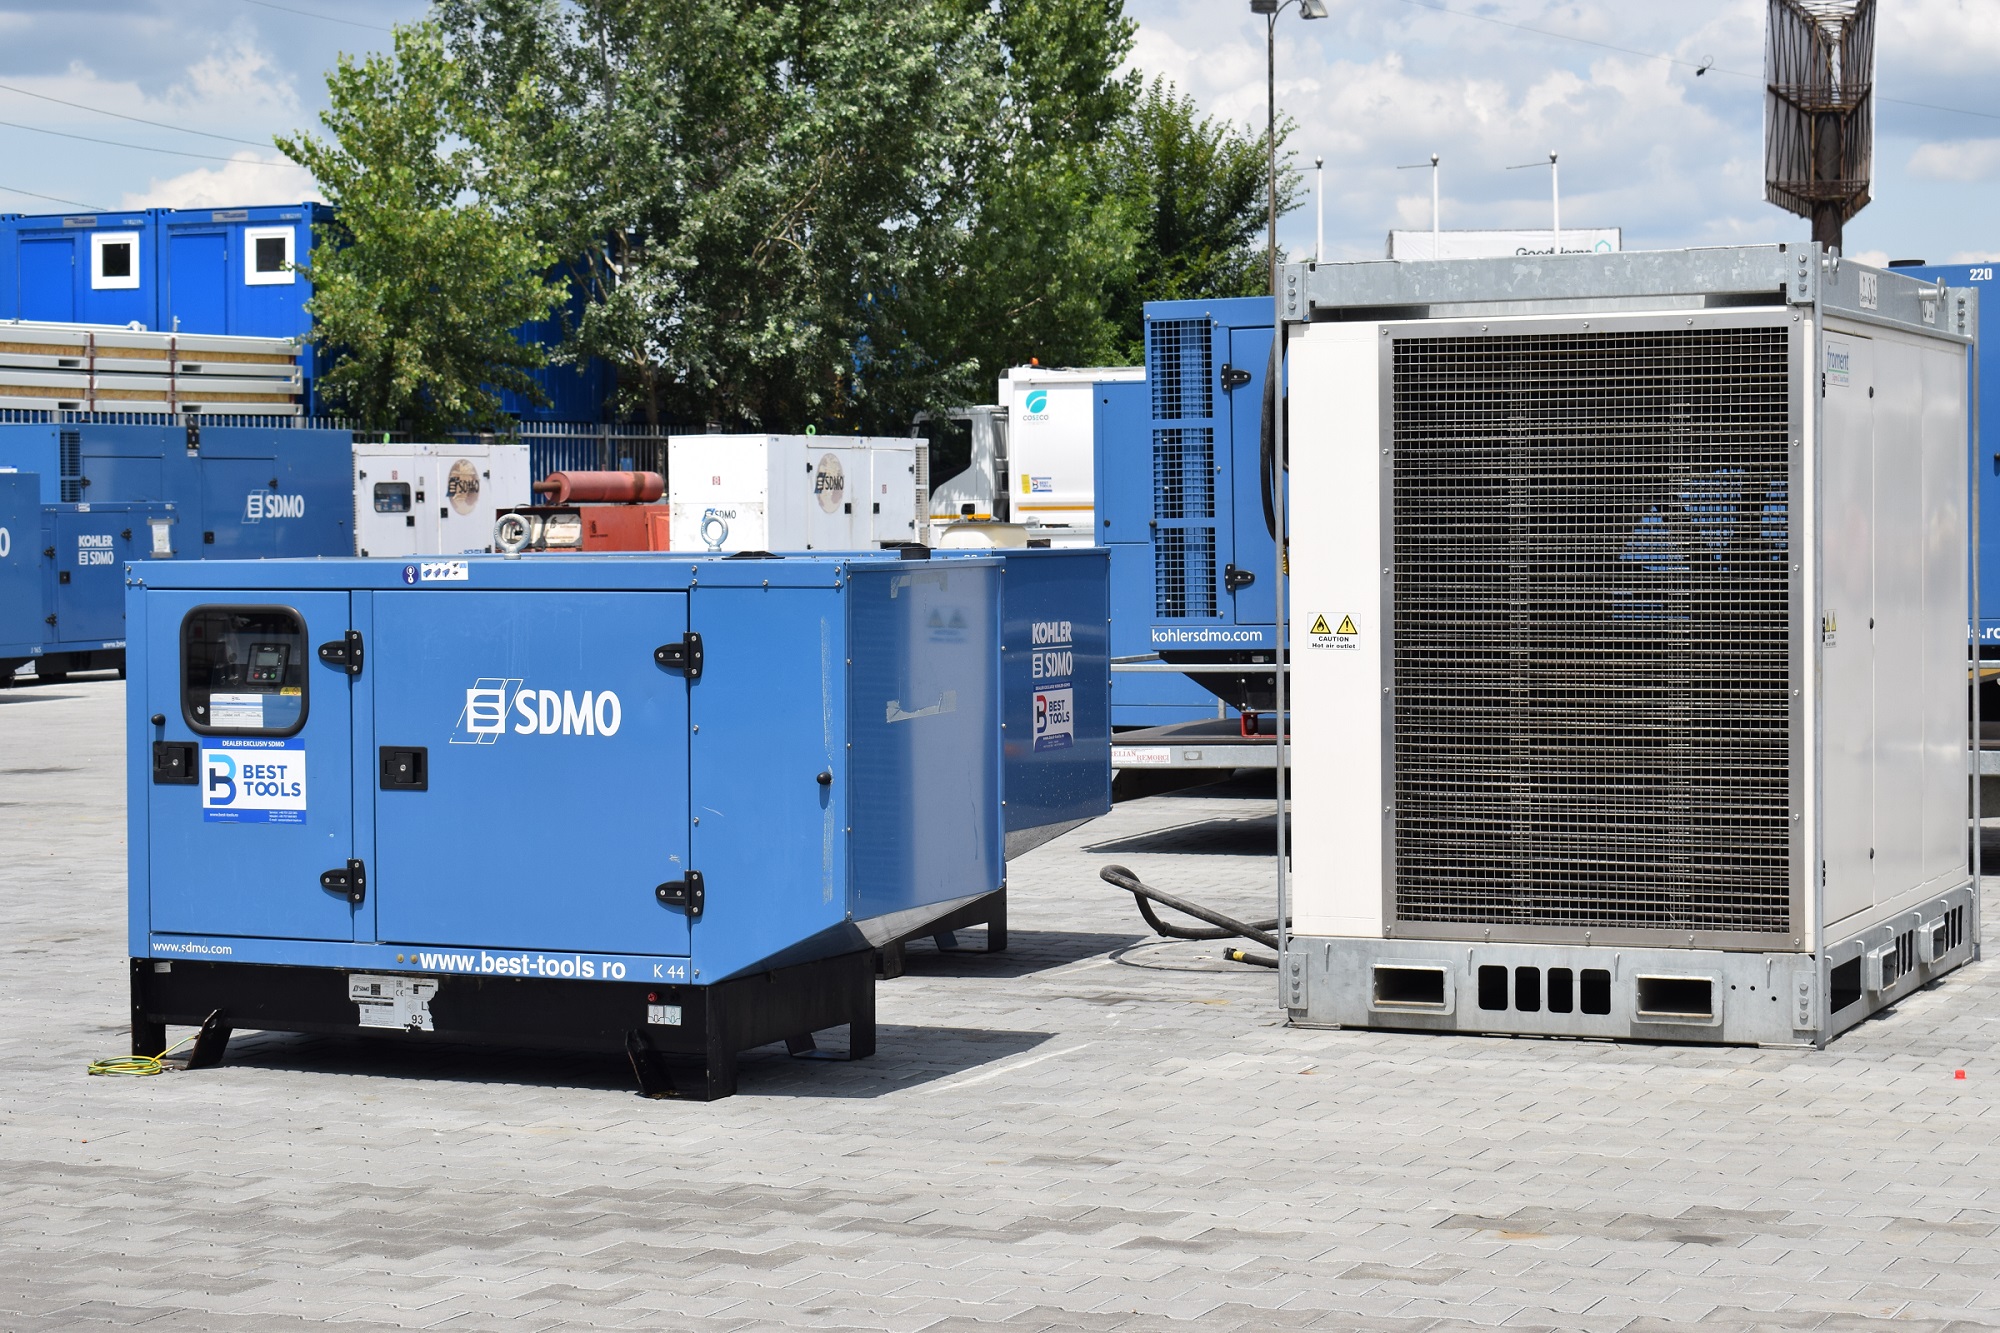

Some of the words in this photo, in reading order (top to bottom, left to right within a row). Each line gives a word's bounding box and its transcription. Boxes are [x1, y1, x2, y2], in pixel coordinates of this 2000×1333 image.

[1970, 268, 1992, 281] 220
[1827, 345, 1848, 372] froment
[825, 475, 844, 490] SDMO
[265, 494, 304, 518] SDMO
[715, 509, 736, 519] SDMO
[78, 535, 113, 547] KOHLER
[90, 551, 114, 565] SDMO
[1032, 621, 1072, 644] KOHLER
[1152, 628, 1263, 642] kohlersdmo.com
[1045, 651, 1073, 678] SDMO
[514, 689, 622, 737] SDMO
[1048, 700, 1065, 712] BEST
[1049, 712, 1070, 724] TOOLS
[1112, 750, 1136, 758] ELIAN
[243, 765, 287, 779] BEST
[243, 782, 301, 797] TOOLS
[153, 942, 232, 955] www.sdmo.com
[653, 964, 663, 978] K
[667, 965, 685, 979] 44
[411, 1014, 424, 1025] 93
